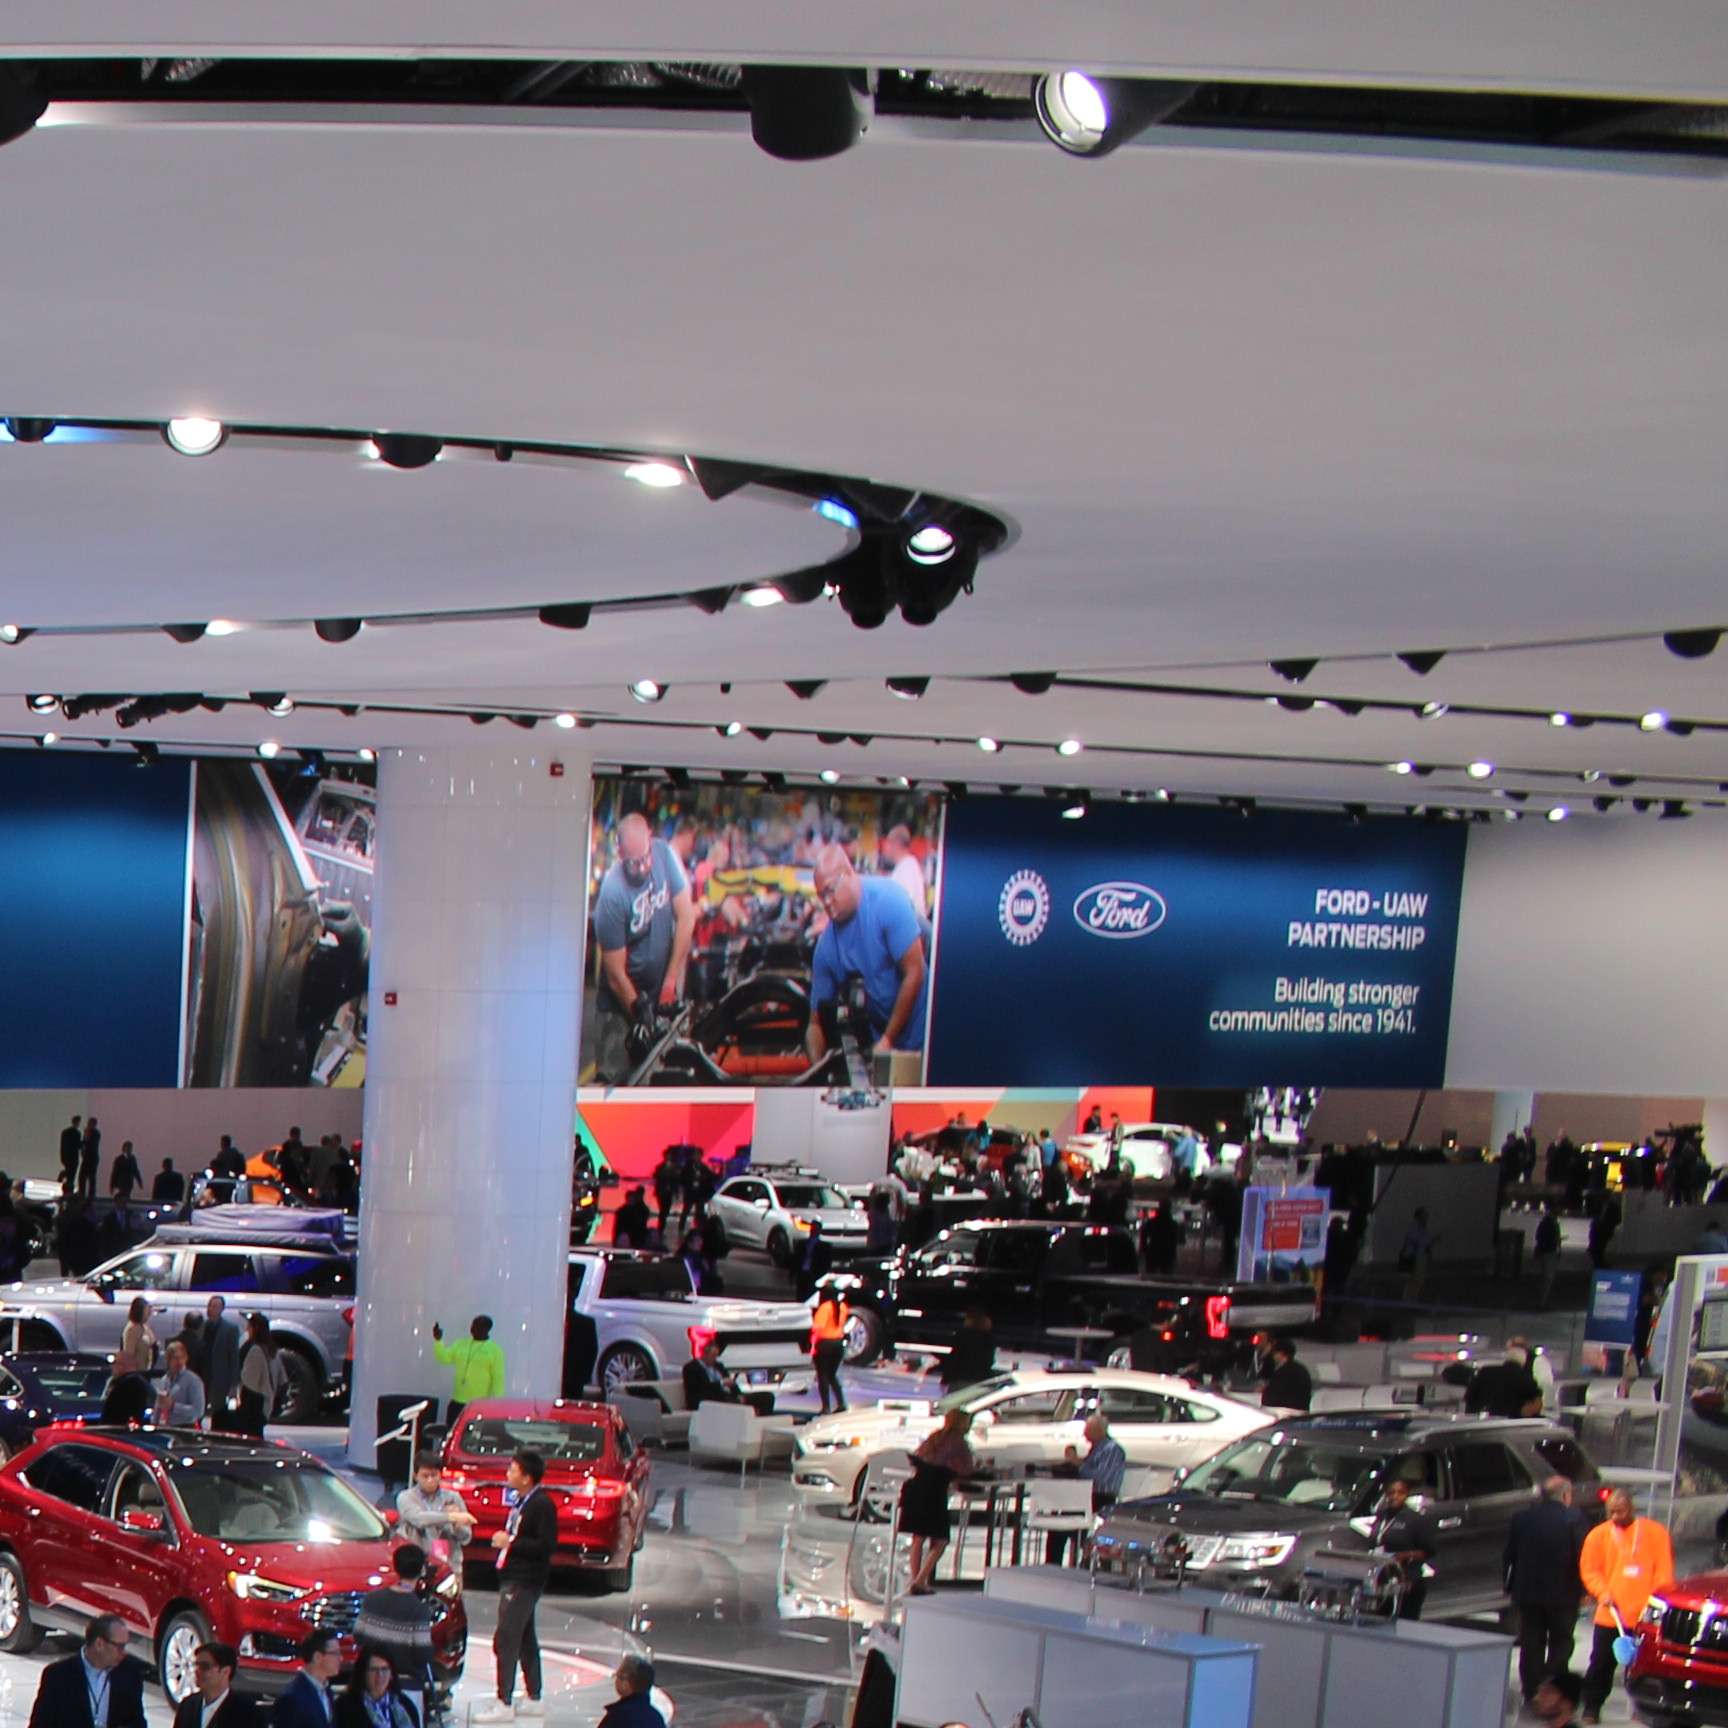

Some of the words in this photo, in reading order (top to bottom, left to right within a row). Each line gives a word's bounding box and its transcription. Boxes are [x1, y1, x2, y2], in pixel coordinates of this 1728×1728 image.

[1089, 888, 1150, 929] Ford
[1315, 889, 1370, 915] FORD
[1384, 892, 1428, 917] UAW
[1288, 922, 1425, 949] PARTNERSHIP
[1275, 977, 1345, 1007] Building
[1349, 980, 1419, 1008] stronger
[1209, 1007, 1325, 1032] communities
[1328, 1008, 1372, 1033] since
[1377, 1008, 1416, 1033] 1941.
